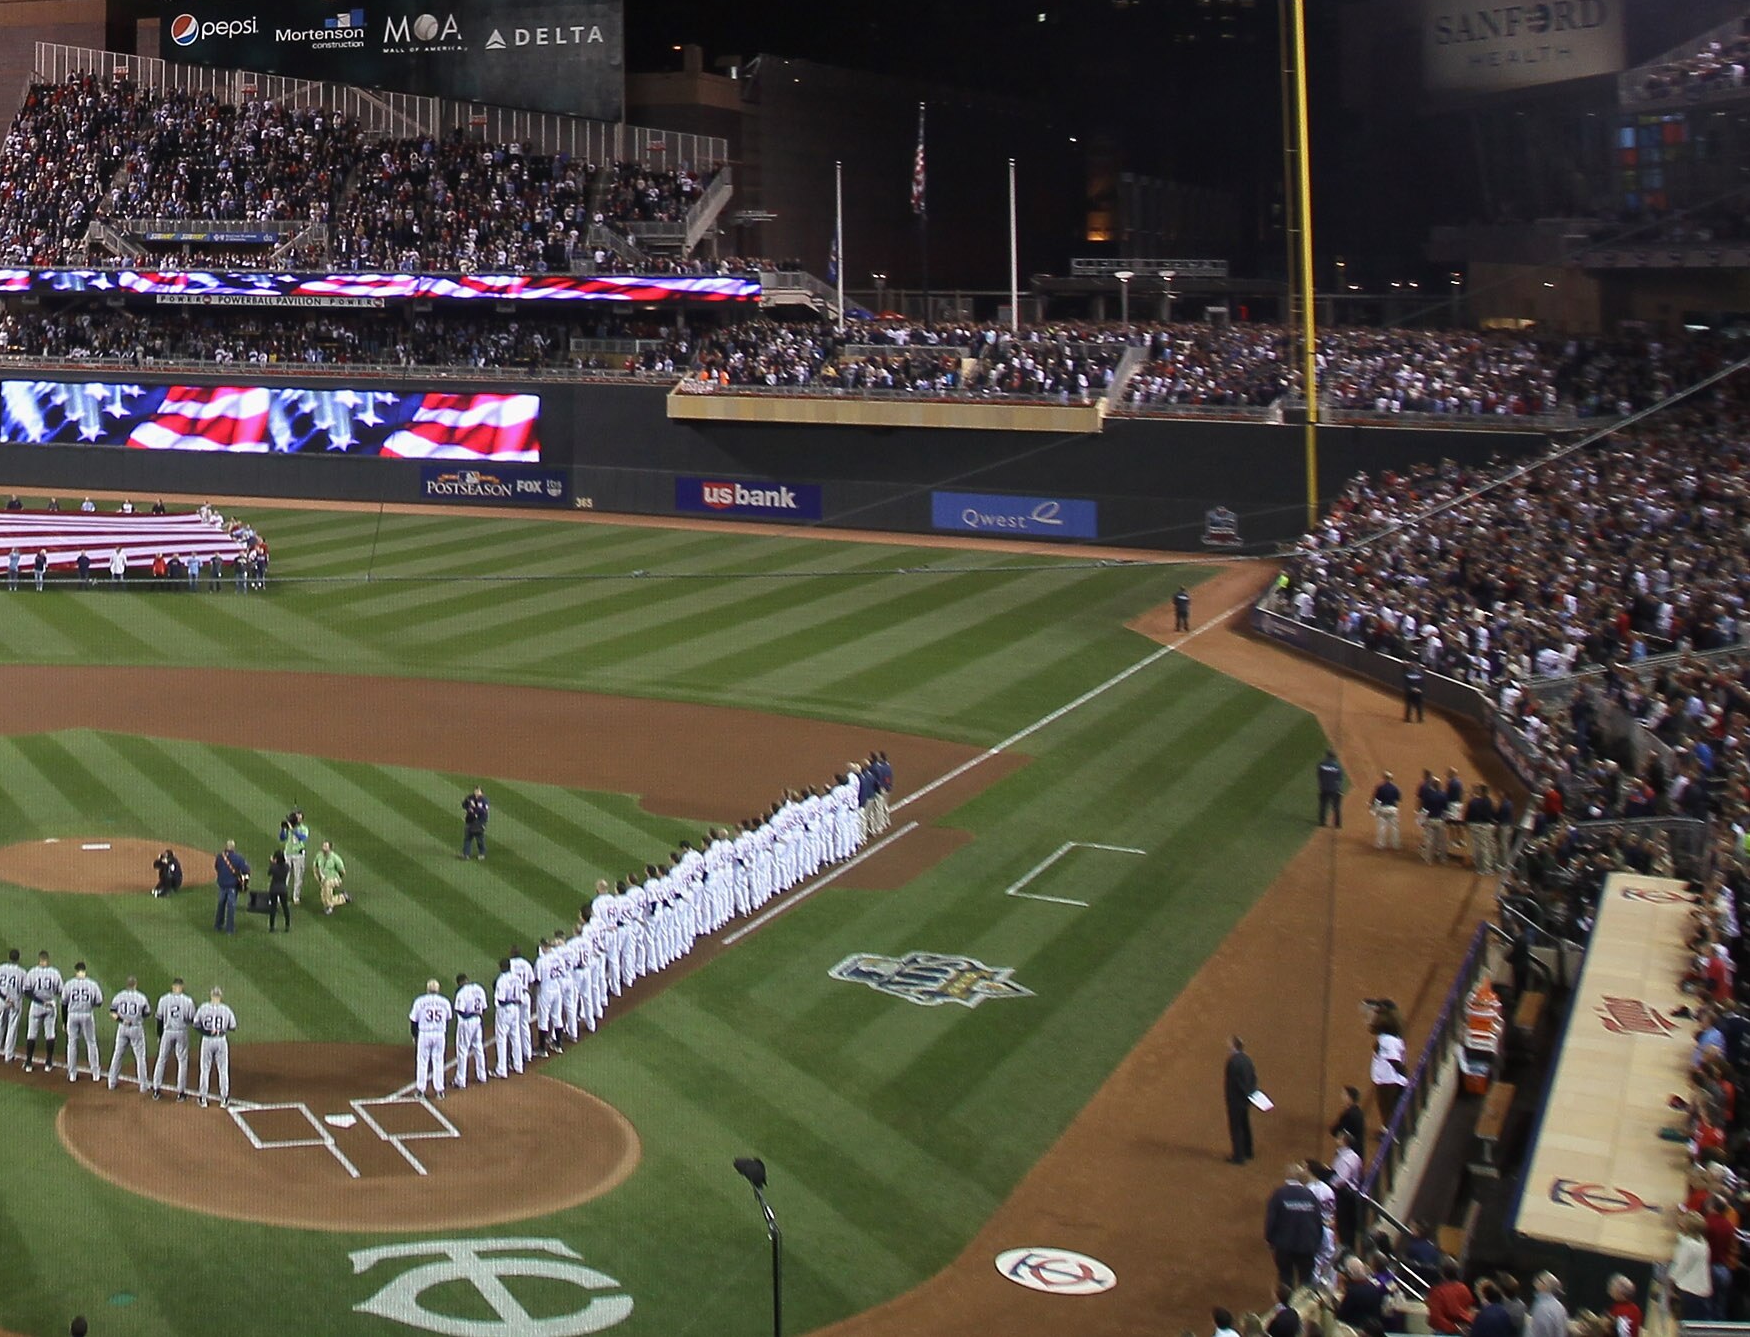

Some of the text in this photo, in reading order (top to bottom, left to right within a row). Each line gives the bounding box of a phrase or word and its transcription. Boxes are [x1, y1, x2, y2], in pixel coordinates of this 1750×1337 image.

[201, 16, 258, 40] pepsi
[275, 28, 364, 43] Mortenson
[514, 26, 604, 46] DELTA
[312, 40, 364, 50] construction
[218, 296, 273, 305] POWERBALL
[277, 297, 321, 306] PAVILION
[427, 480, 512, 497] POSTSEASON
[516, 479, 543, 493] FOX
[962, 508, 1028, 529] Qwest
[0, 973, 16, 989] 24
[37, 977, 52, 991] 13
[71, 988, 90, 1002] 25
[120, 1002, 138, 1016] 33
[170, 1005, 180, 1019] 2
[203, 1016, 223, 1031] 28
